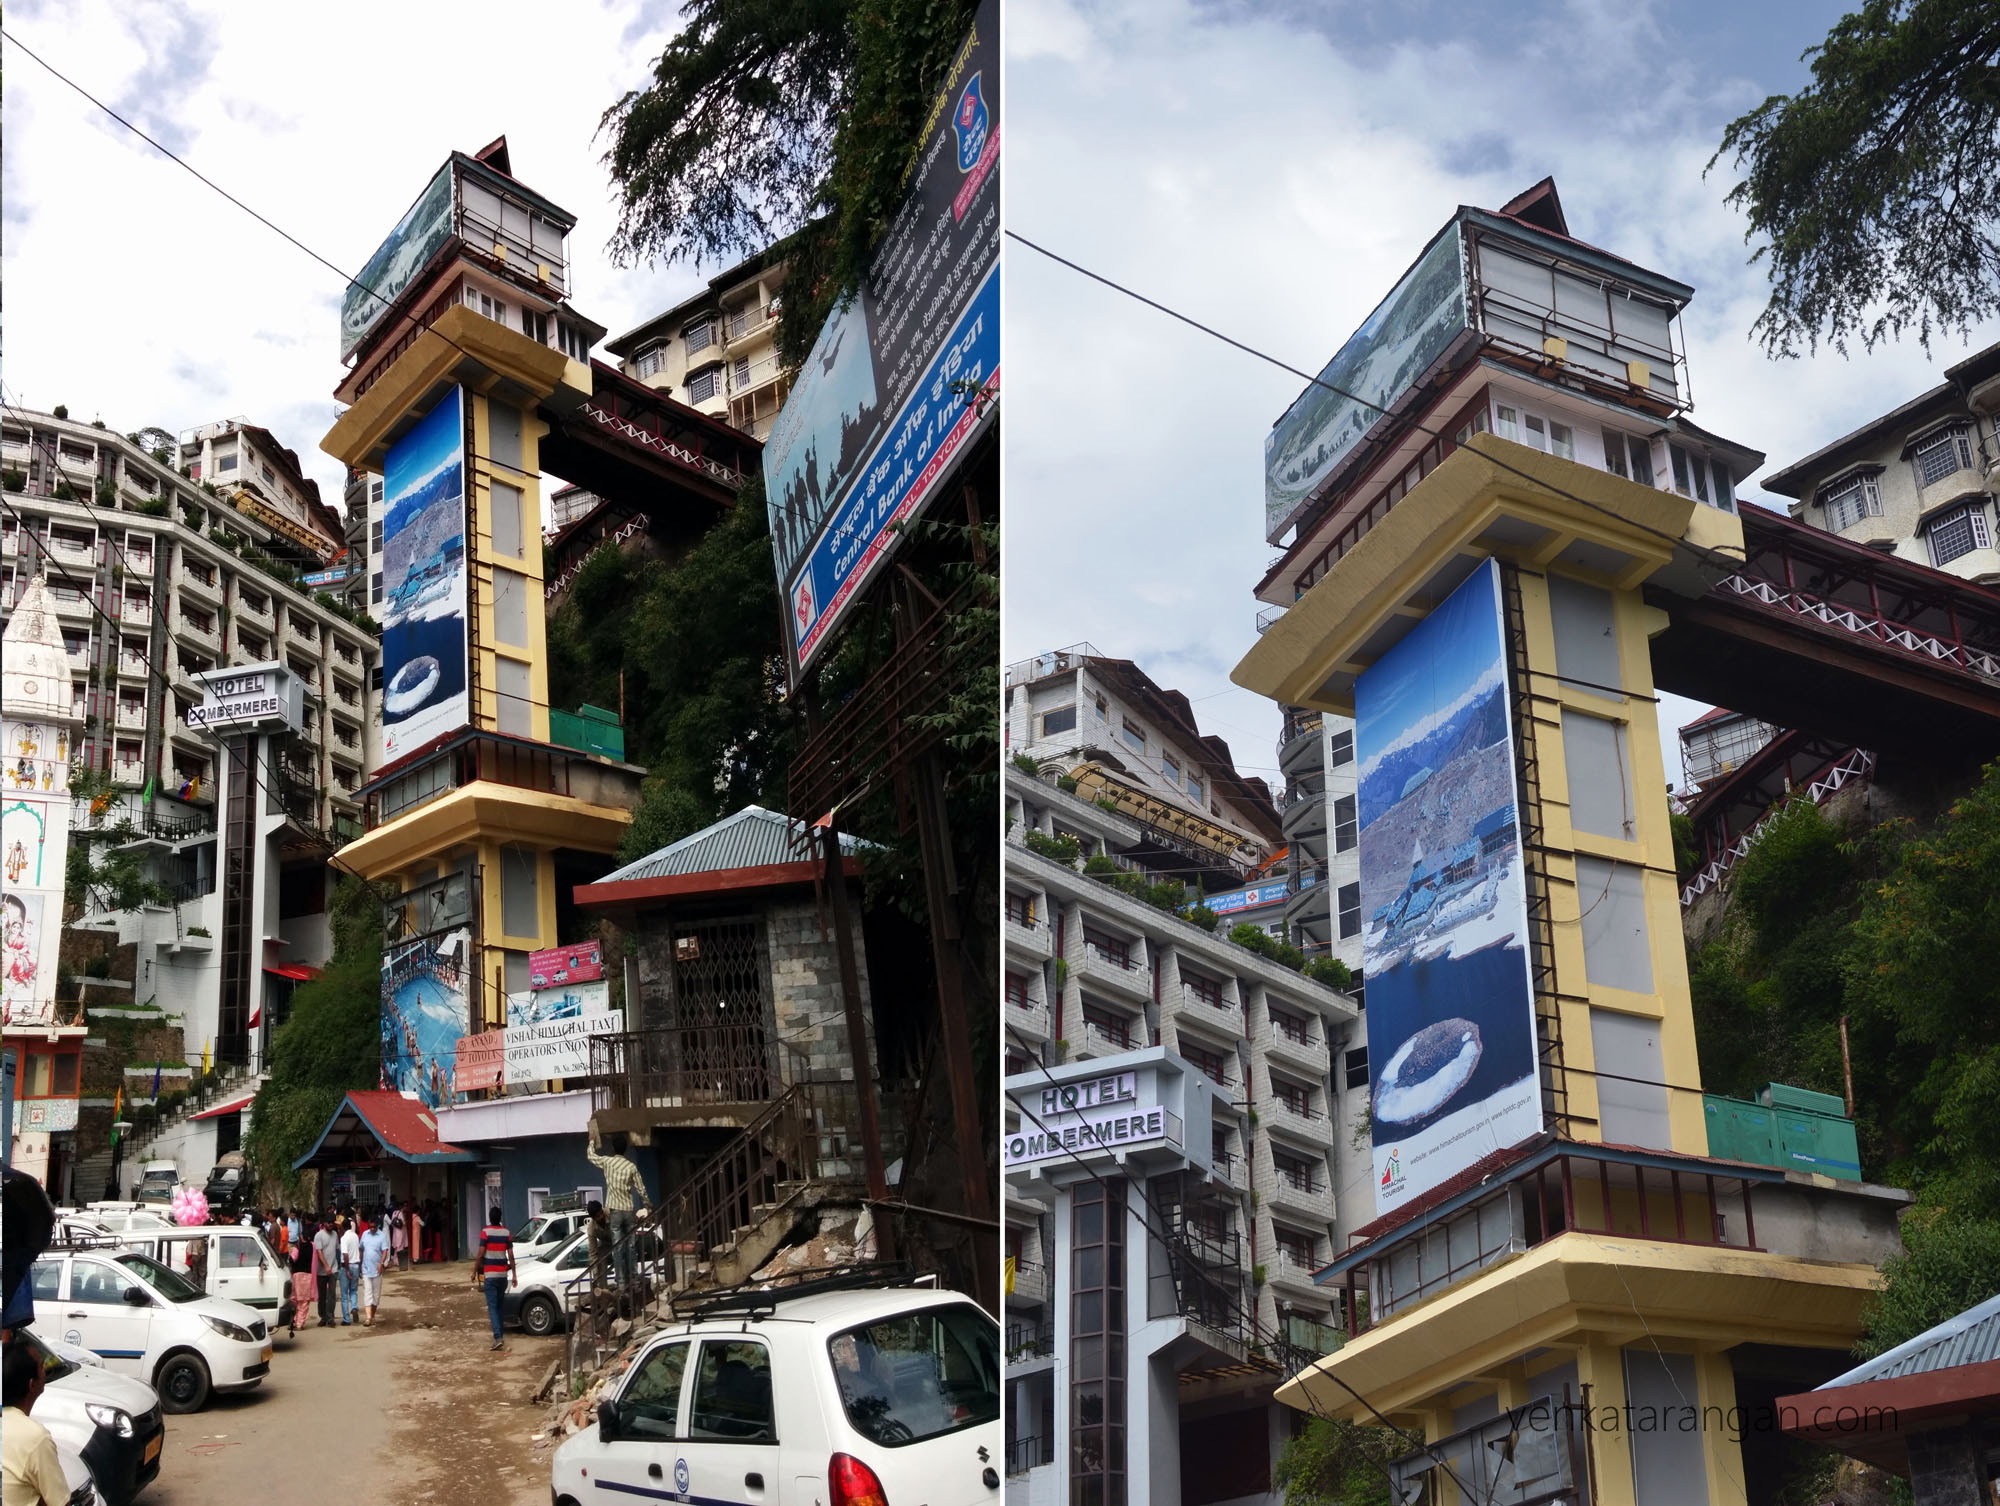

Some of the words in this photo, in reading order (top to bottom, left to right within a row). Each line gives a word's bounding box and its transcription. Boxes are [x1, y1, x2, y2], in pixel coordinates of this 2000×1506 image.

[919, 87, 947, 151] आकर्षक
[915, 163, 927, 191] सभी
[903, 224, 910, 239] पर
[905, 266, 917, 292] सभी
[930, 230, 937, 246] के
[876, 300, 882, 316] का
[908, 296, 915, 311] पर
[916, 352, 922, 367] के
[866, 454, 891, 498] बैंक
[931, 312, 983, 401] इंडिया
[835, 508, 873, 580] Central
[879, 458, 913, 519] Bank
[918, 420, 933, 461] of
[938, 360, 981, 433] India
[802, 637, 813, 656] 1911
[923, 464, 936, 483] TO
[938, 429, 960, 461] YOU
[963, 376, 998, 429] SIE
[215, 676, 262, 695] HOTEL
[188, 698, 277, 722] COMBERMERE
[506, 1028, 537, 1043] VISHAL
[538, 1020, 588, 1039] HIMACHAL
[589, 1016, 614, 1032] TAXI
[468, 1049, 497, 1063] TOYOTA
[508, 1044, 557, 1061] OPERATORS
[559, 1039, 588, 1054] UNION
[1041, 1075, 1132, 1113] HOTEL
[1381, 1175, 1407, 1192] HIMACHAL
[1382, 1184, 1405, 1199] TOURISM
